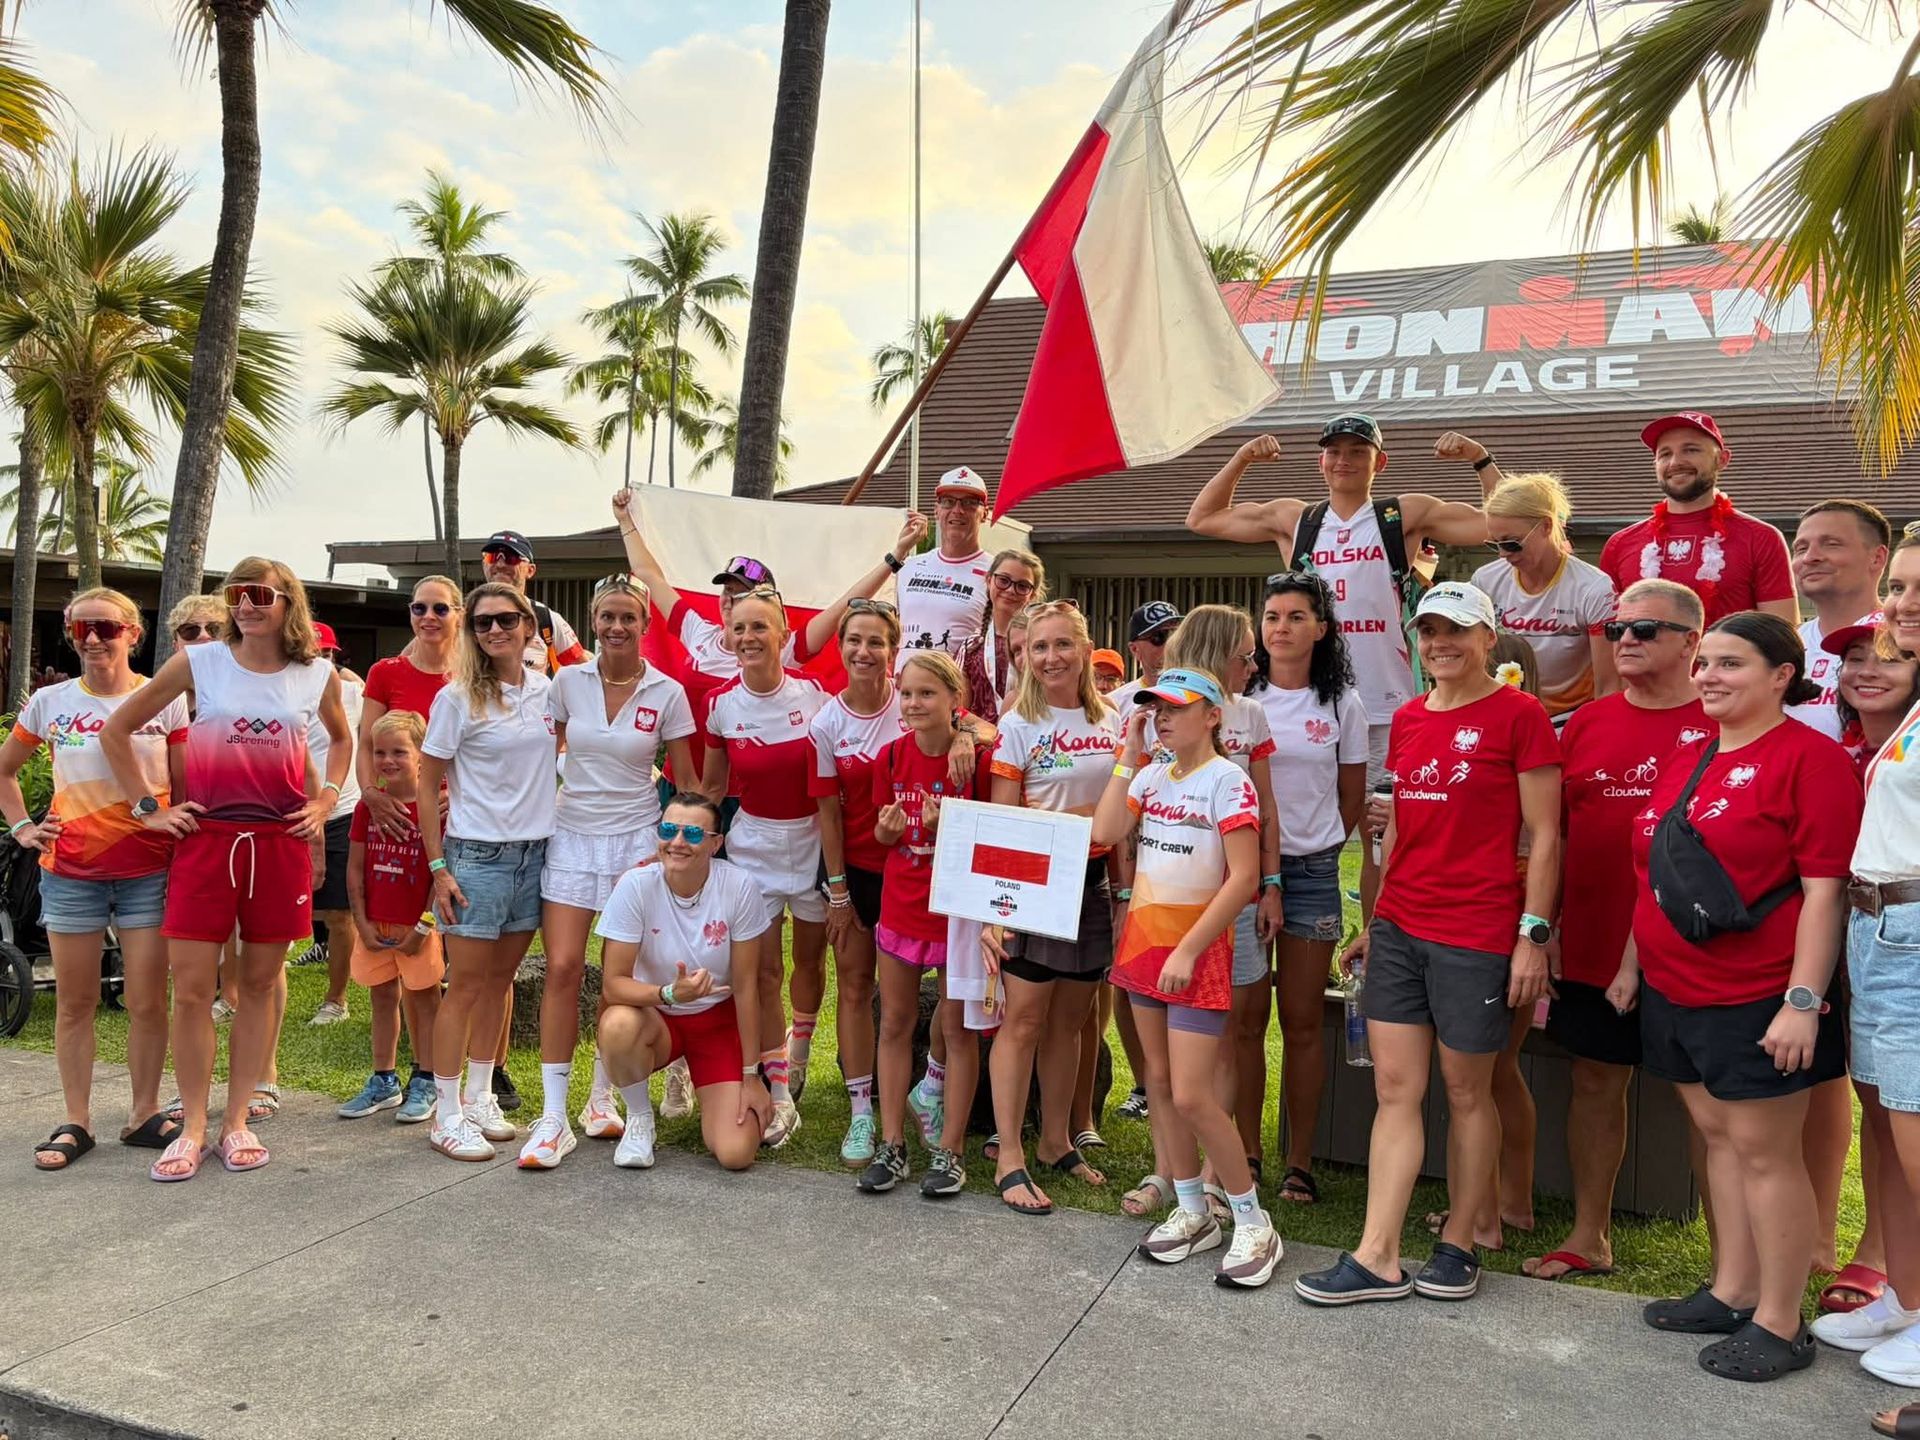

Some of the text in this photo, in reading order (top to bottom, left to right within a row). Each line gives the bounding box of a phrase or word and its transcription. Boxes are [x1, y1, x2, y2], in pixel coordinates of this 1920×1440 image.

[1241, 276, 1815, 365] RONMAN
[1329, 354, 1640, 402] VILLAGE
[1311, 545, 1385, 566] OLSKA
[1336, 579, 1346, 601] 9
[1500, 607, 1561, 632] Kona
[64, 711, 106, 734] Ko
[226, 734, 280, 749] JStrening
[1049, 729, 1115, 754] Kona
[1140, 787, 1189, 820] Kona
[1398, 788, 1449, 801] cloudware
[1160, 842, 1194, 855] CREW
[994, 880, 1021, 891] POLAND
